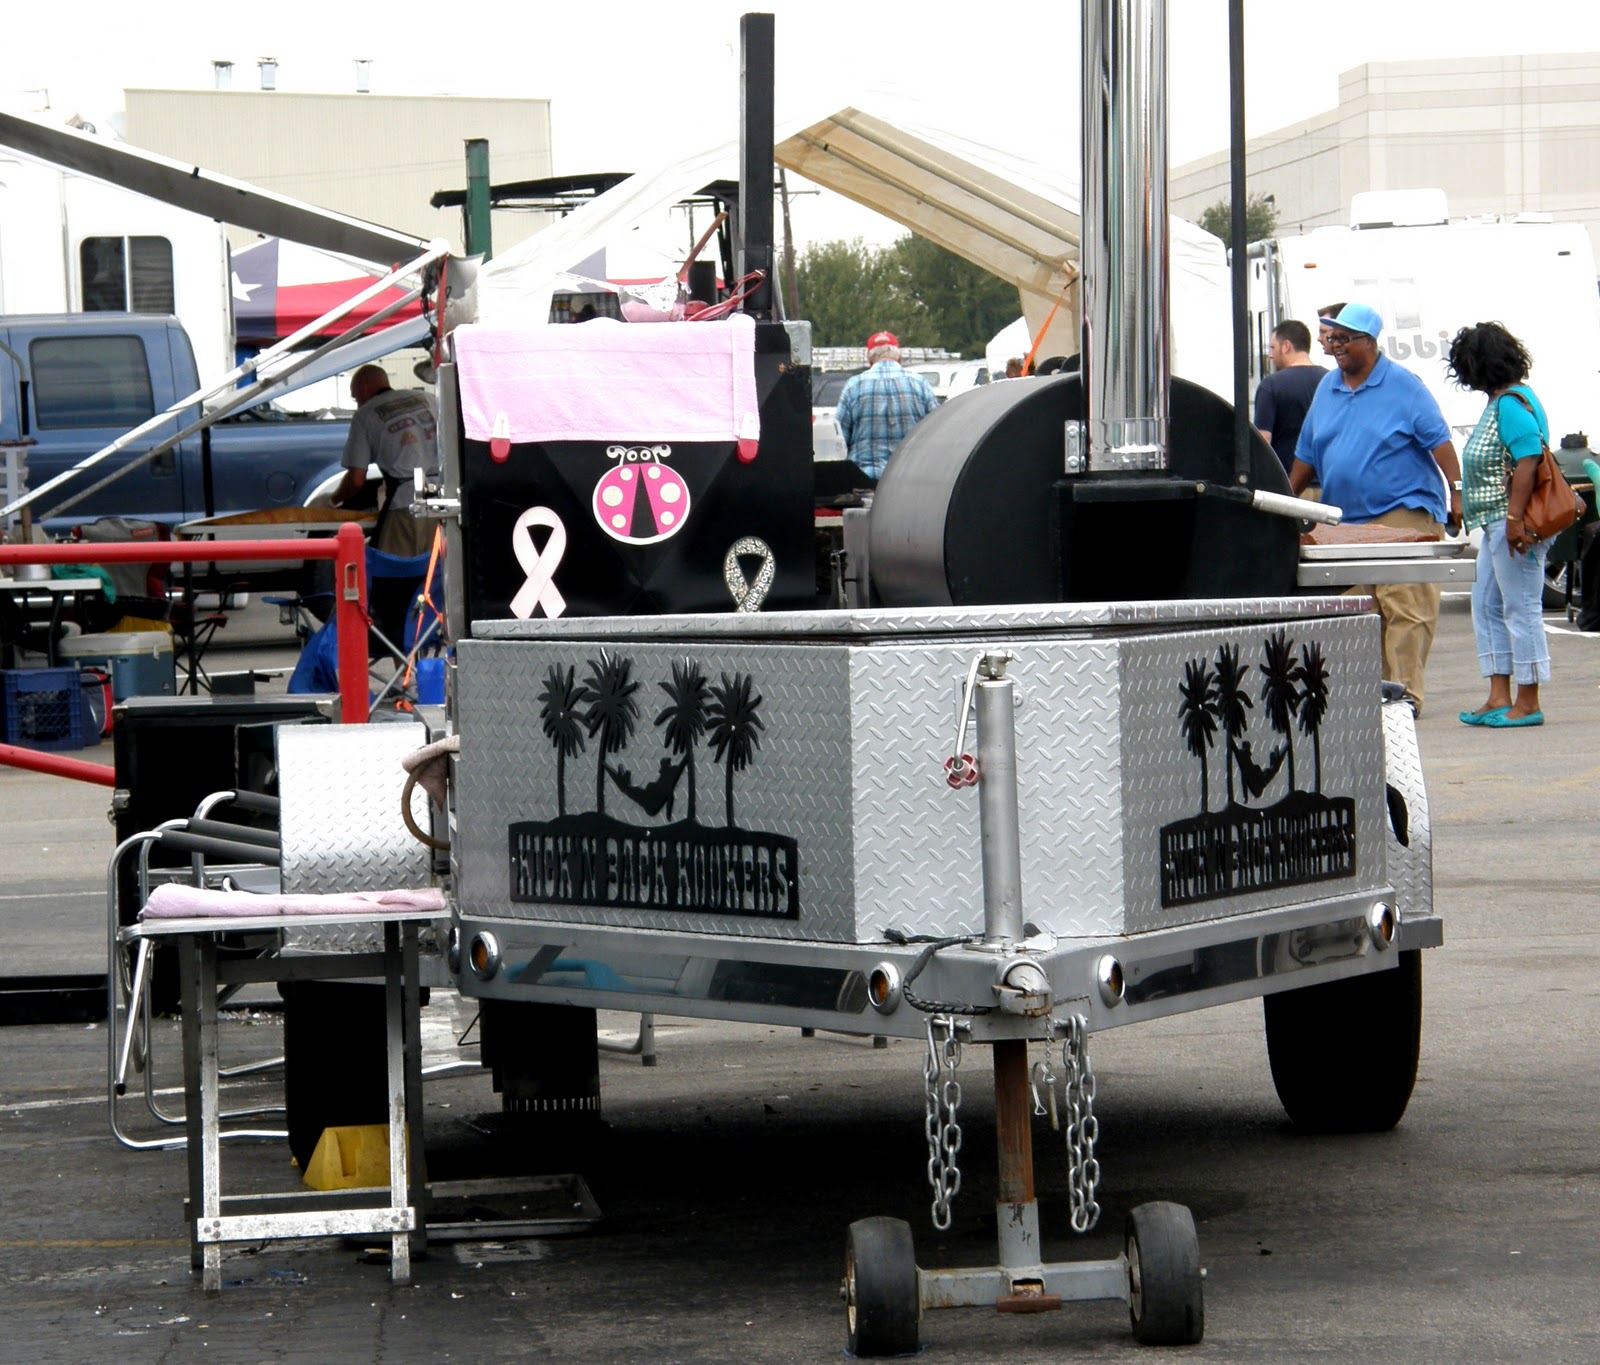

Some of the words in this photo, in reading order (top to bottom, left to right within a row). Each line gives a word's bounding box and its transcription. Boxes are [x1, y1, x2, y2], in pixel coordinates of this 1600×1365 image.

[746, 592, 760, 608] OUR
[516, 834, 573, 899] KICK
[605, 837, 668, 905] BACK
[675, 840, 790, 914] KOOKERS
[1230, 818, 1274, 889] BACK
